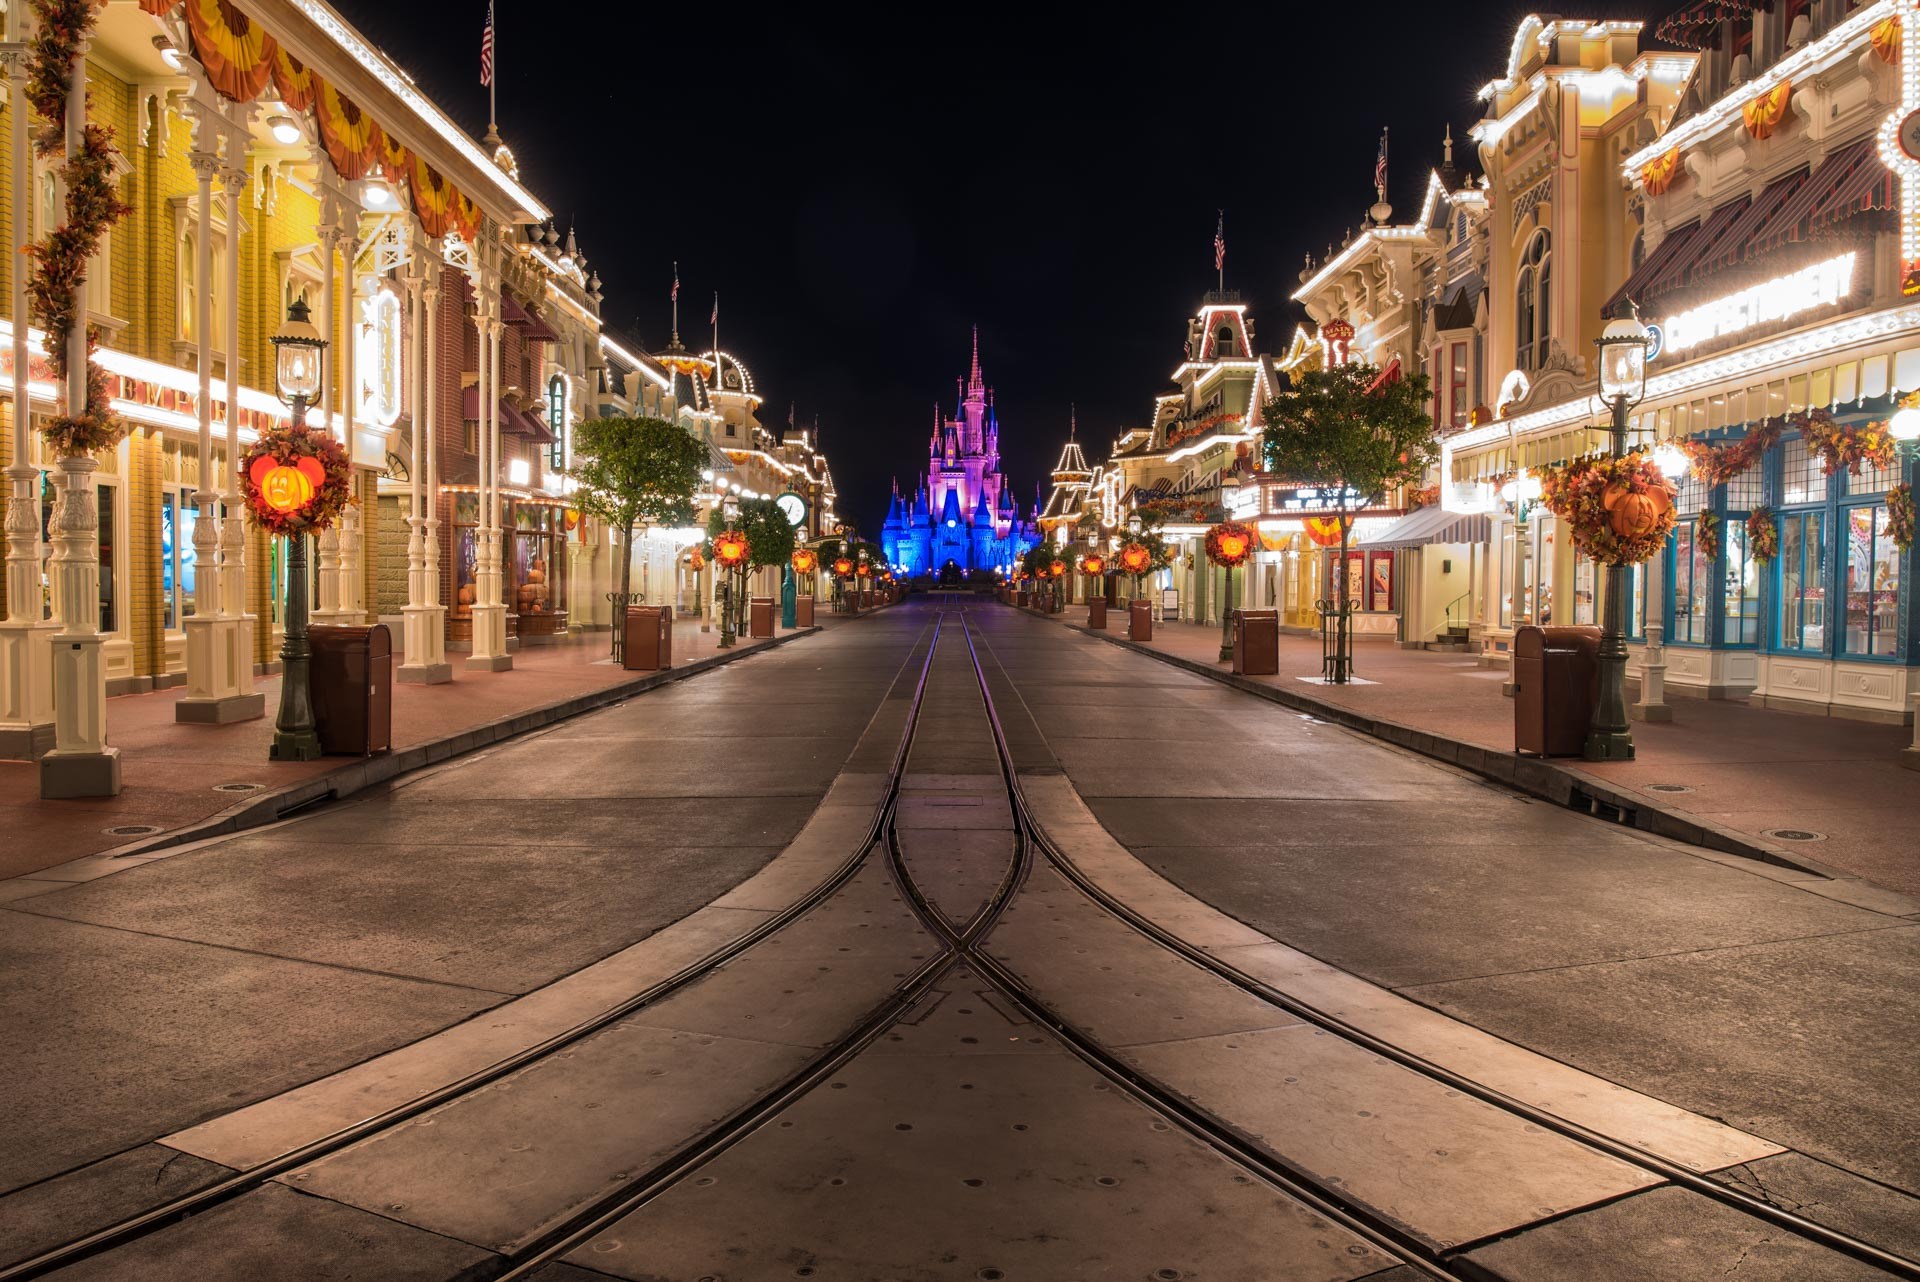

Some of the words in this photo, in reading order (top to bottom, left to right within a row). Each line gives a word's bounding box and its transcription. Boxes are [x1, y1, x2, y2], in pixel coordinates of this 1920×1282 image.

[1325, 326, 1351, 337] MAIN
[119, 373, 283, 432] EMPRUM
[554, 382, 562, 468] ARCADE
